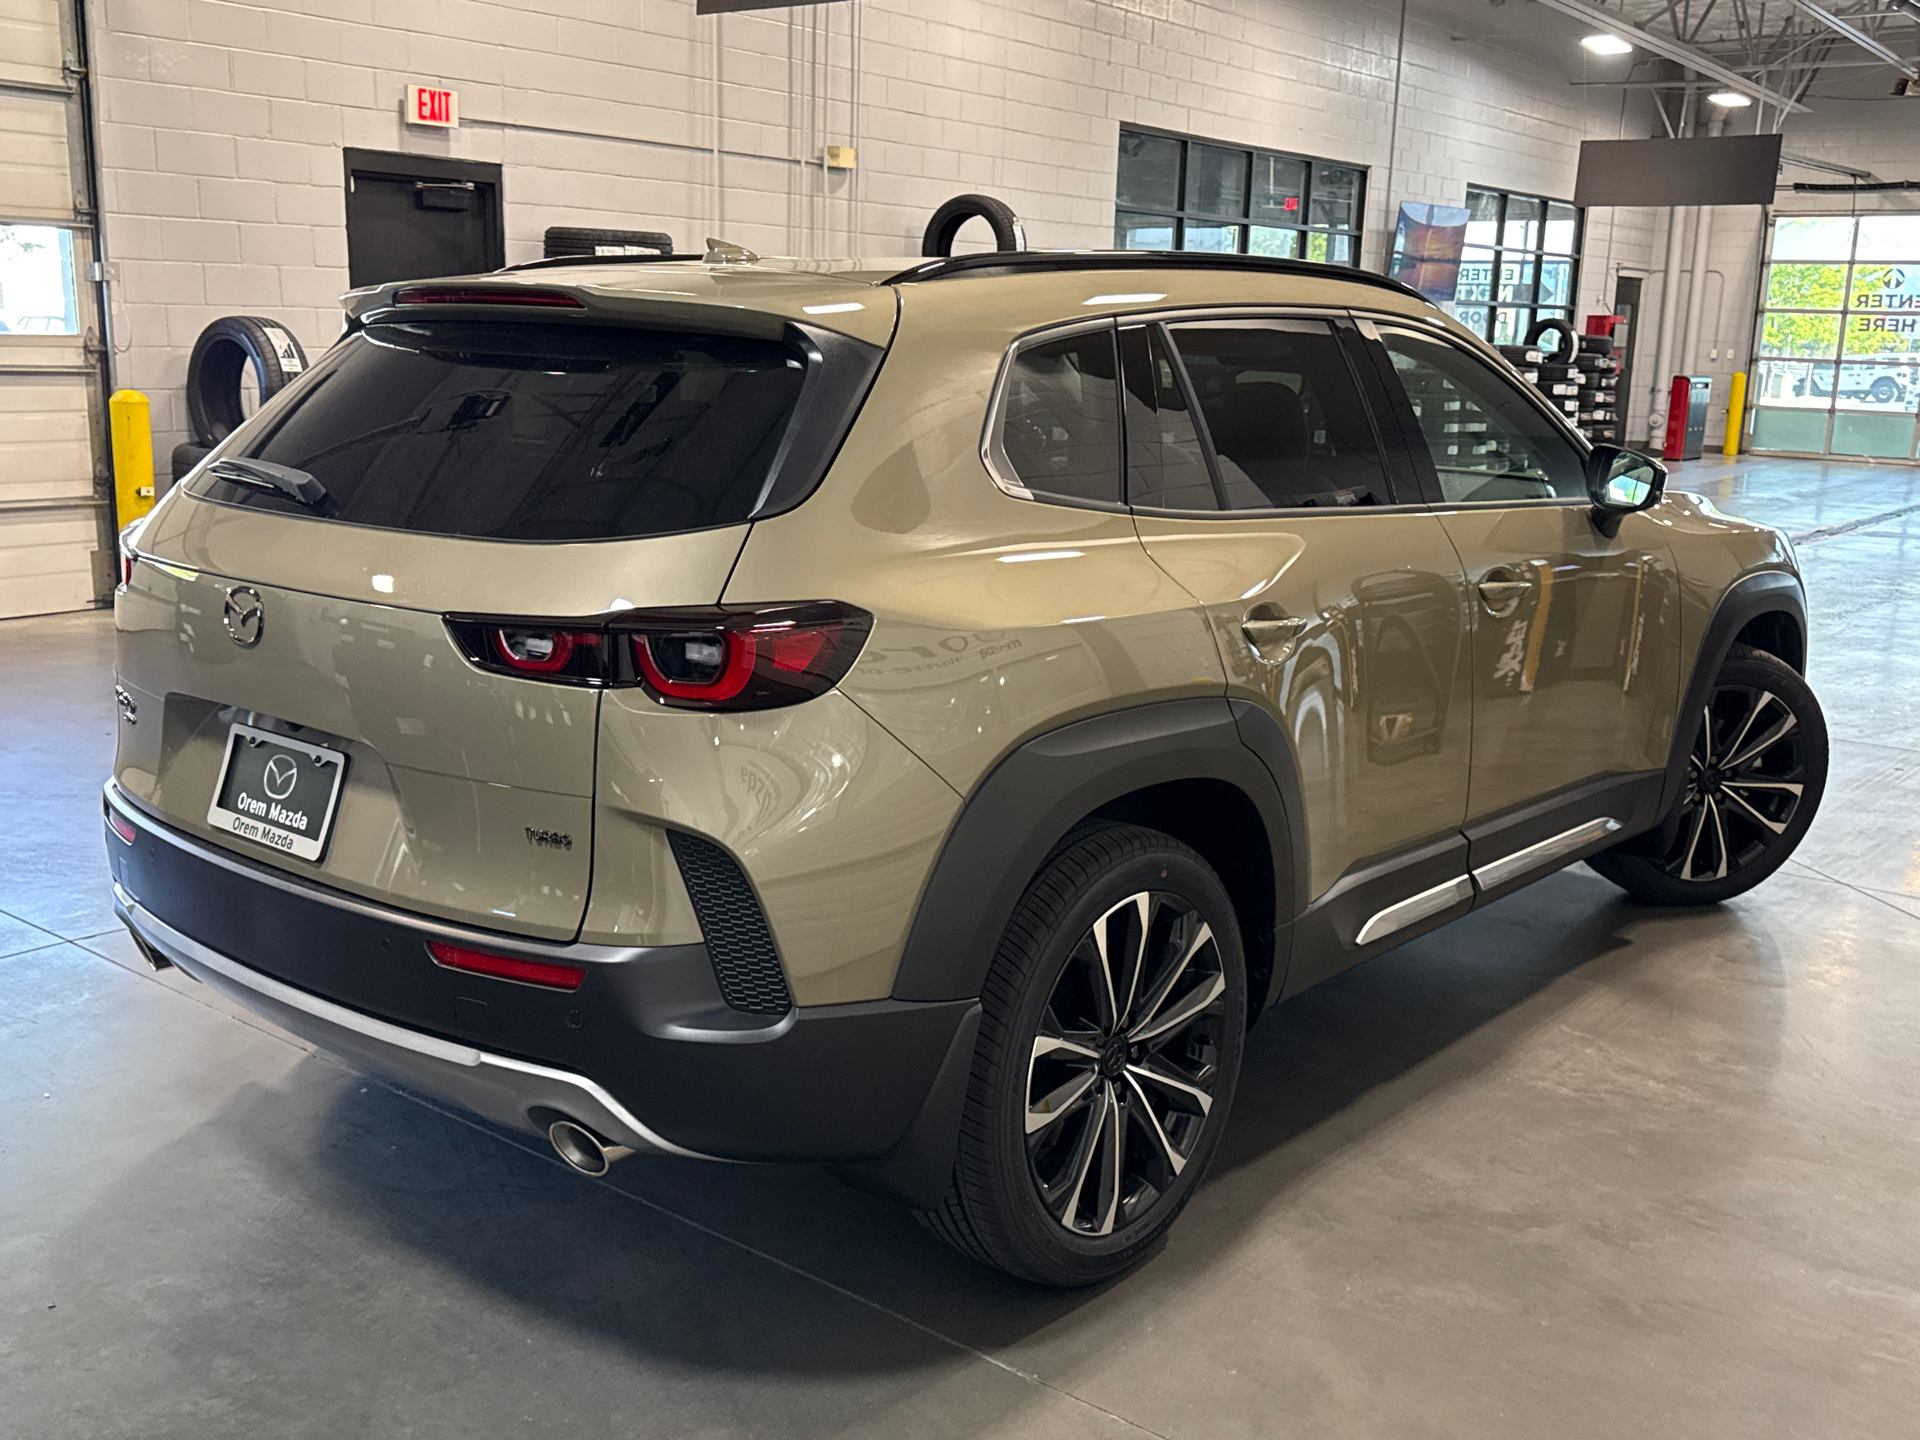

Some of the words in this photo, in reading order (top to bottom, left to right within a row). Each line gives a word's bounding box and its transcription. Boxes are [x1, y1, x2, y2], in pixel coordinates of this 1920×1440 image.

[417, 87, 451, 123] EXIT
[237, 791, 267, 818] Orem
[268, 801, 308, 831] Mazda
[232, 816, 259, 838] Orem
[260, 825, 294, 850] Mazda
[525, 827, 573, 846] TURBO
